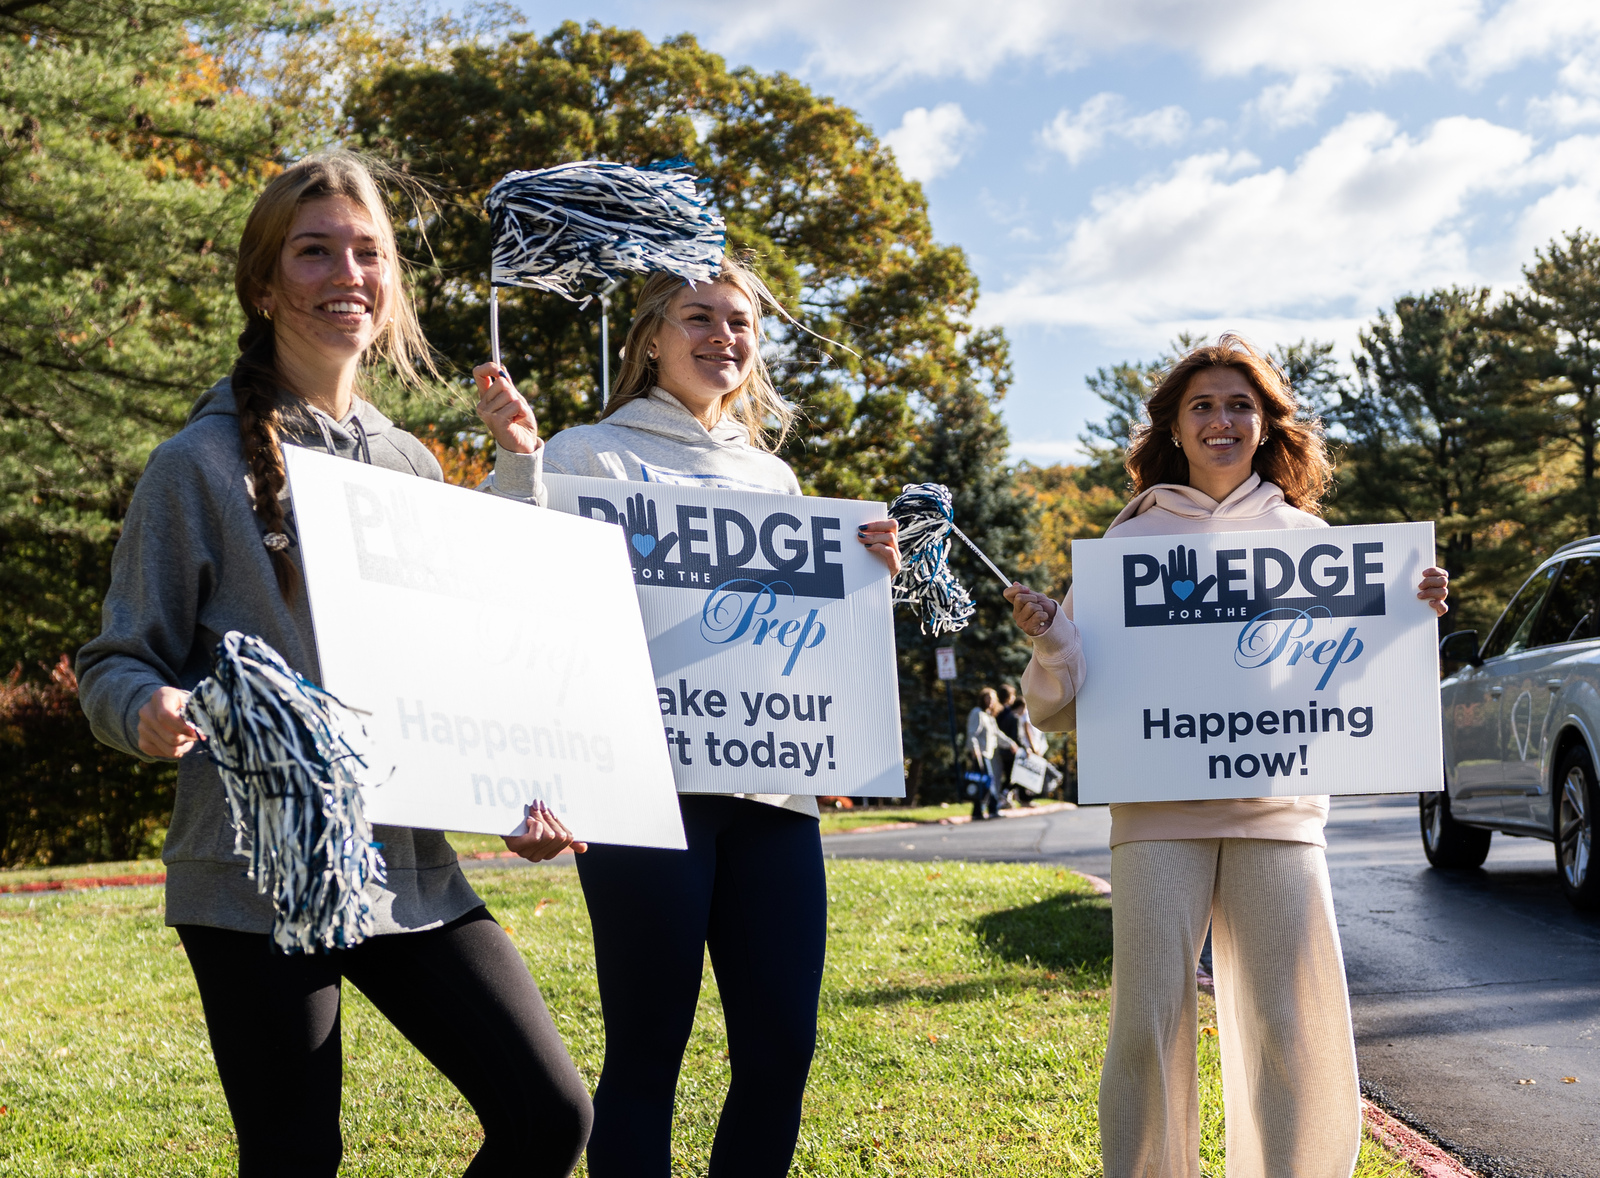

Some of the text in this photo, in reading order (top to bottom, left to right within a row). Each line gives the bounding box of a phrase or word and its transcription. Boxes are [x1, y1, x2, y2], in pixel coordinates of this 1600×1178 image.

[678, 571, 711, 583] THE
[1123, 541, 1386, 611] PLEDGE
[700, 578, 826, 676] Prep
[1168, 606, 1247, 620] FOR THE
[1234, 605, 1364, 691] Prep
[656, 678, 833, 727] ake your
[1143, 700, 1374, 744] Happening
[396, 696, 615, 773] Happening
[705, 731, 837, 777] today!
[1208, 744, 1309, 780] now!
[470, 773, 568, 813] now!
